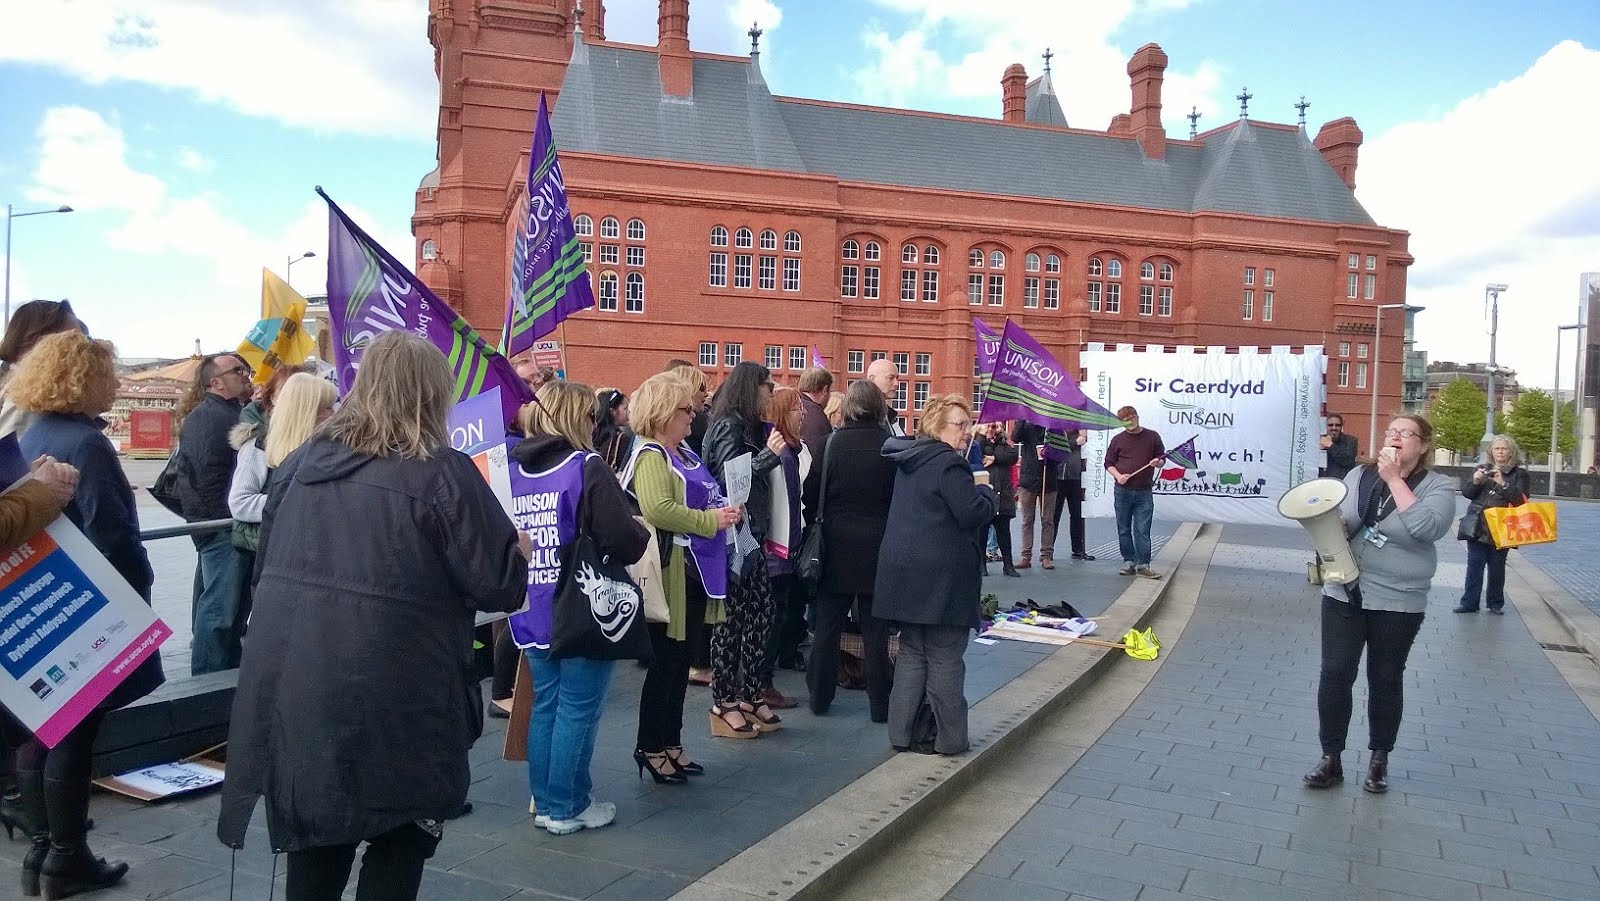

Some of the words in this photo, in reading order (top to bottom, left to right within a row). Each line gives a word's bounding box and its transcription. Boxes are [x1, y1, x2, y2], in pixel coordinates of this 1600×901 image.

[1004, 350, 1064, 387] UNISON
[1041, 386, 1058, 398] union
[1097, 371, 1106, 400] nerth
[1134, 377, 1162, 393] Sir
[1169, 378, 1265, 398] Caerdydd
[1168, 410, 1234, 427] UNSAIN
